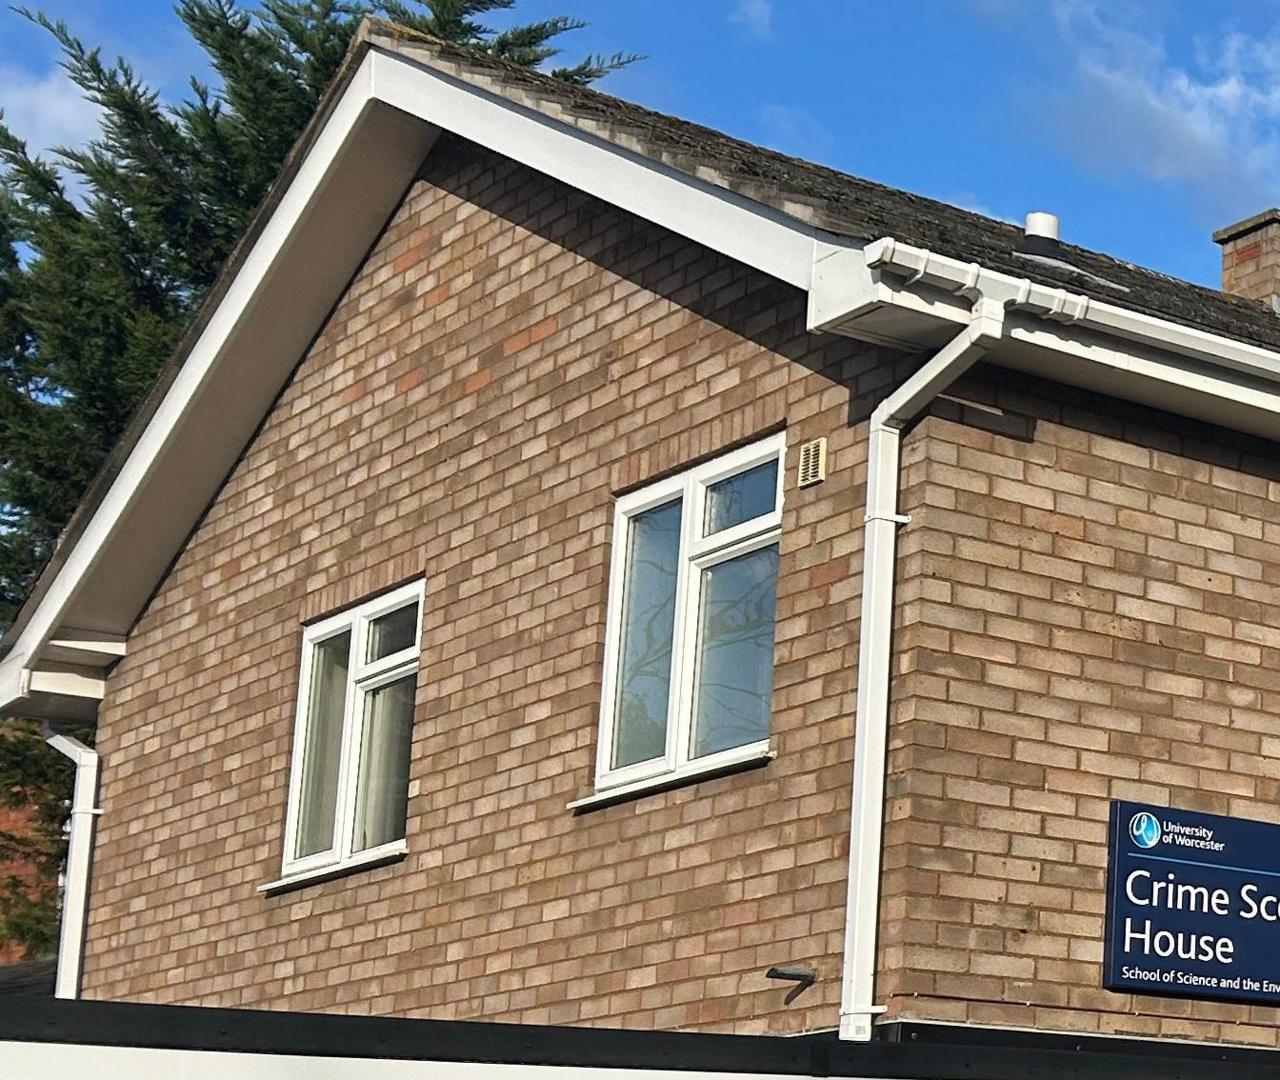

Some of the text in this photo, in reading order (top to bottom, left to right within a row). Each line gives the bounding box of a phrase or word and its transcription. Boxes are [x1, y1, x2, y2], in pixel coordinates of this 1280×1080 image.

[1162, 833, 1226, 851] of Worcester
[1163, 821, 1214, 841] University
[1125, 869, 1230, 915] Crime
[1123, 917, 1235, 964] House
[1121, 966, 1161, 983] School
[1162, 970, 1175, 983] of
[1176, 971, 1218, 988] Science
[1219, 976, 1241, 990] and
[1242, 978, 1261, 991] the
